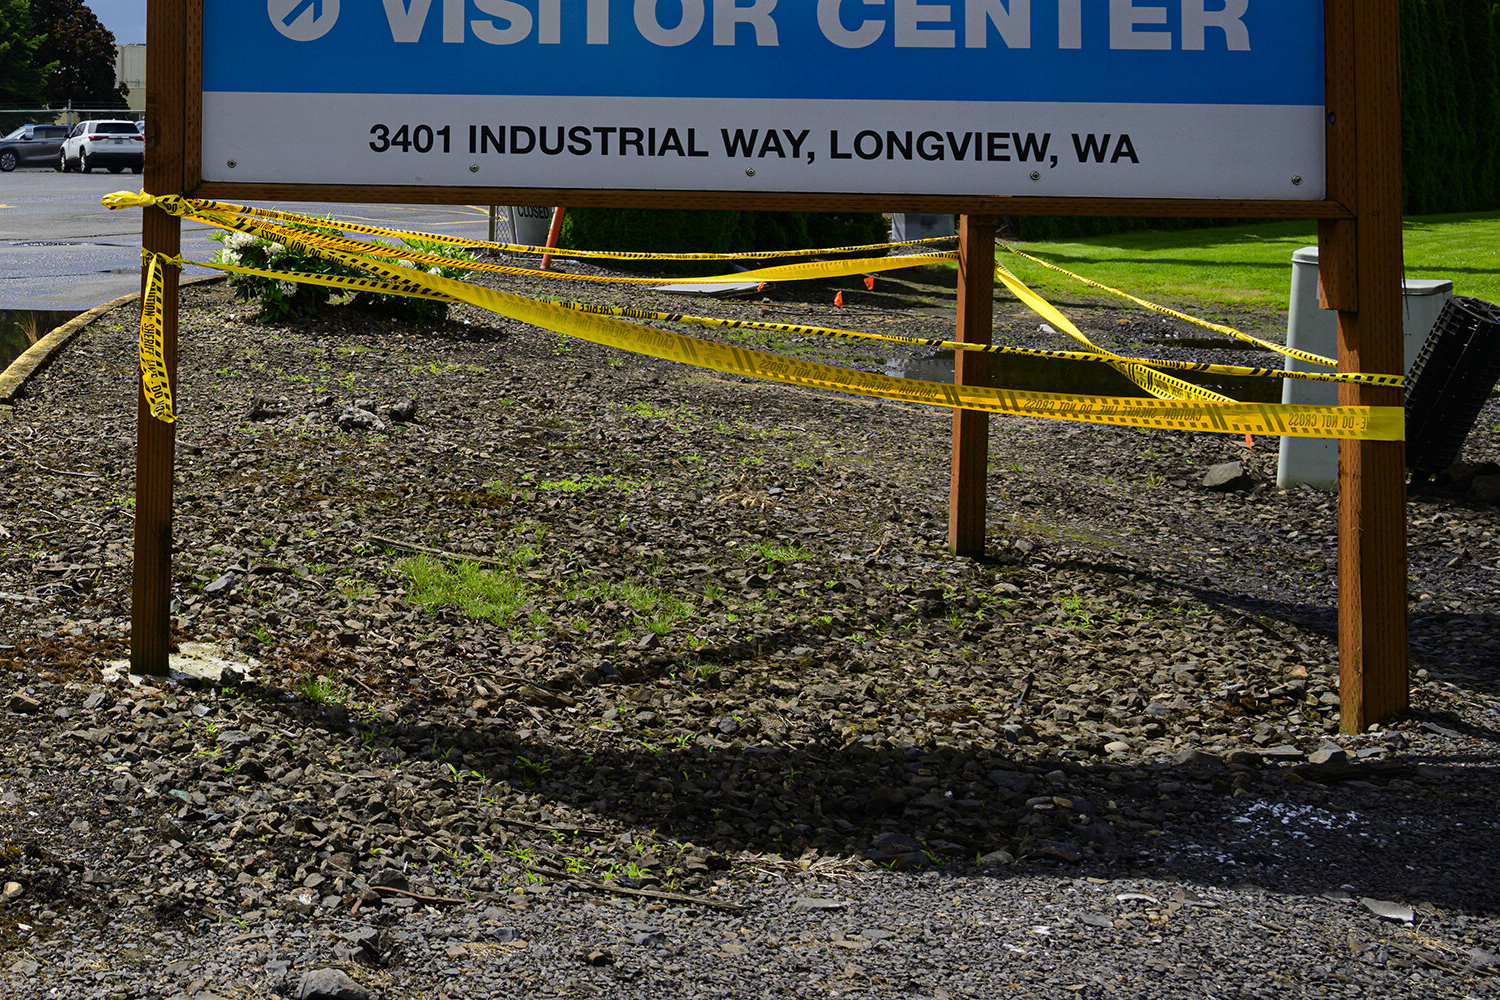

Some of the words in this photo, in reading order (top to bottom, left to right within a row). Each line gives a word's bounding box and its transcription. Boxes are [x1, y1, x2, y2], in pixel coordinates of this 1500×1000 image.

[368, 123, 451, 154] 3401
[469, 124, 709, 158] INDUSTRIAL
[720, 128, 815, 165] WAY,
[830, 129, 1058, 169] LONGVIEW,
[1070, 133, 1140, 164] WA
[517, 205, 550, 219] CLOSED
